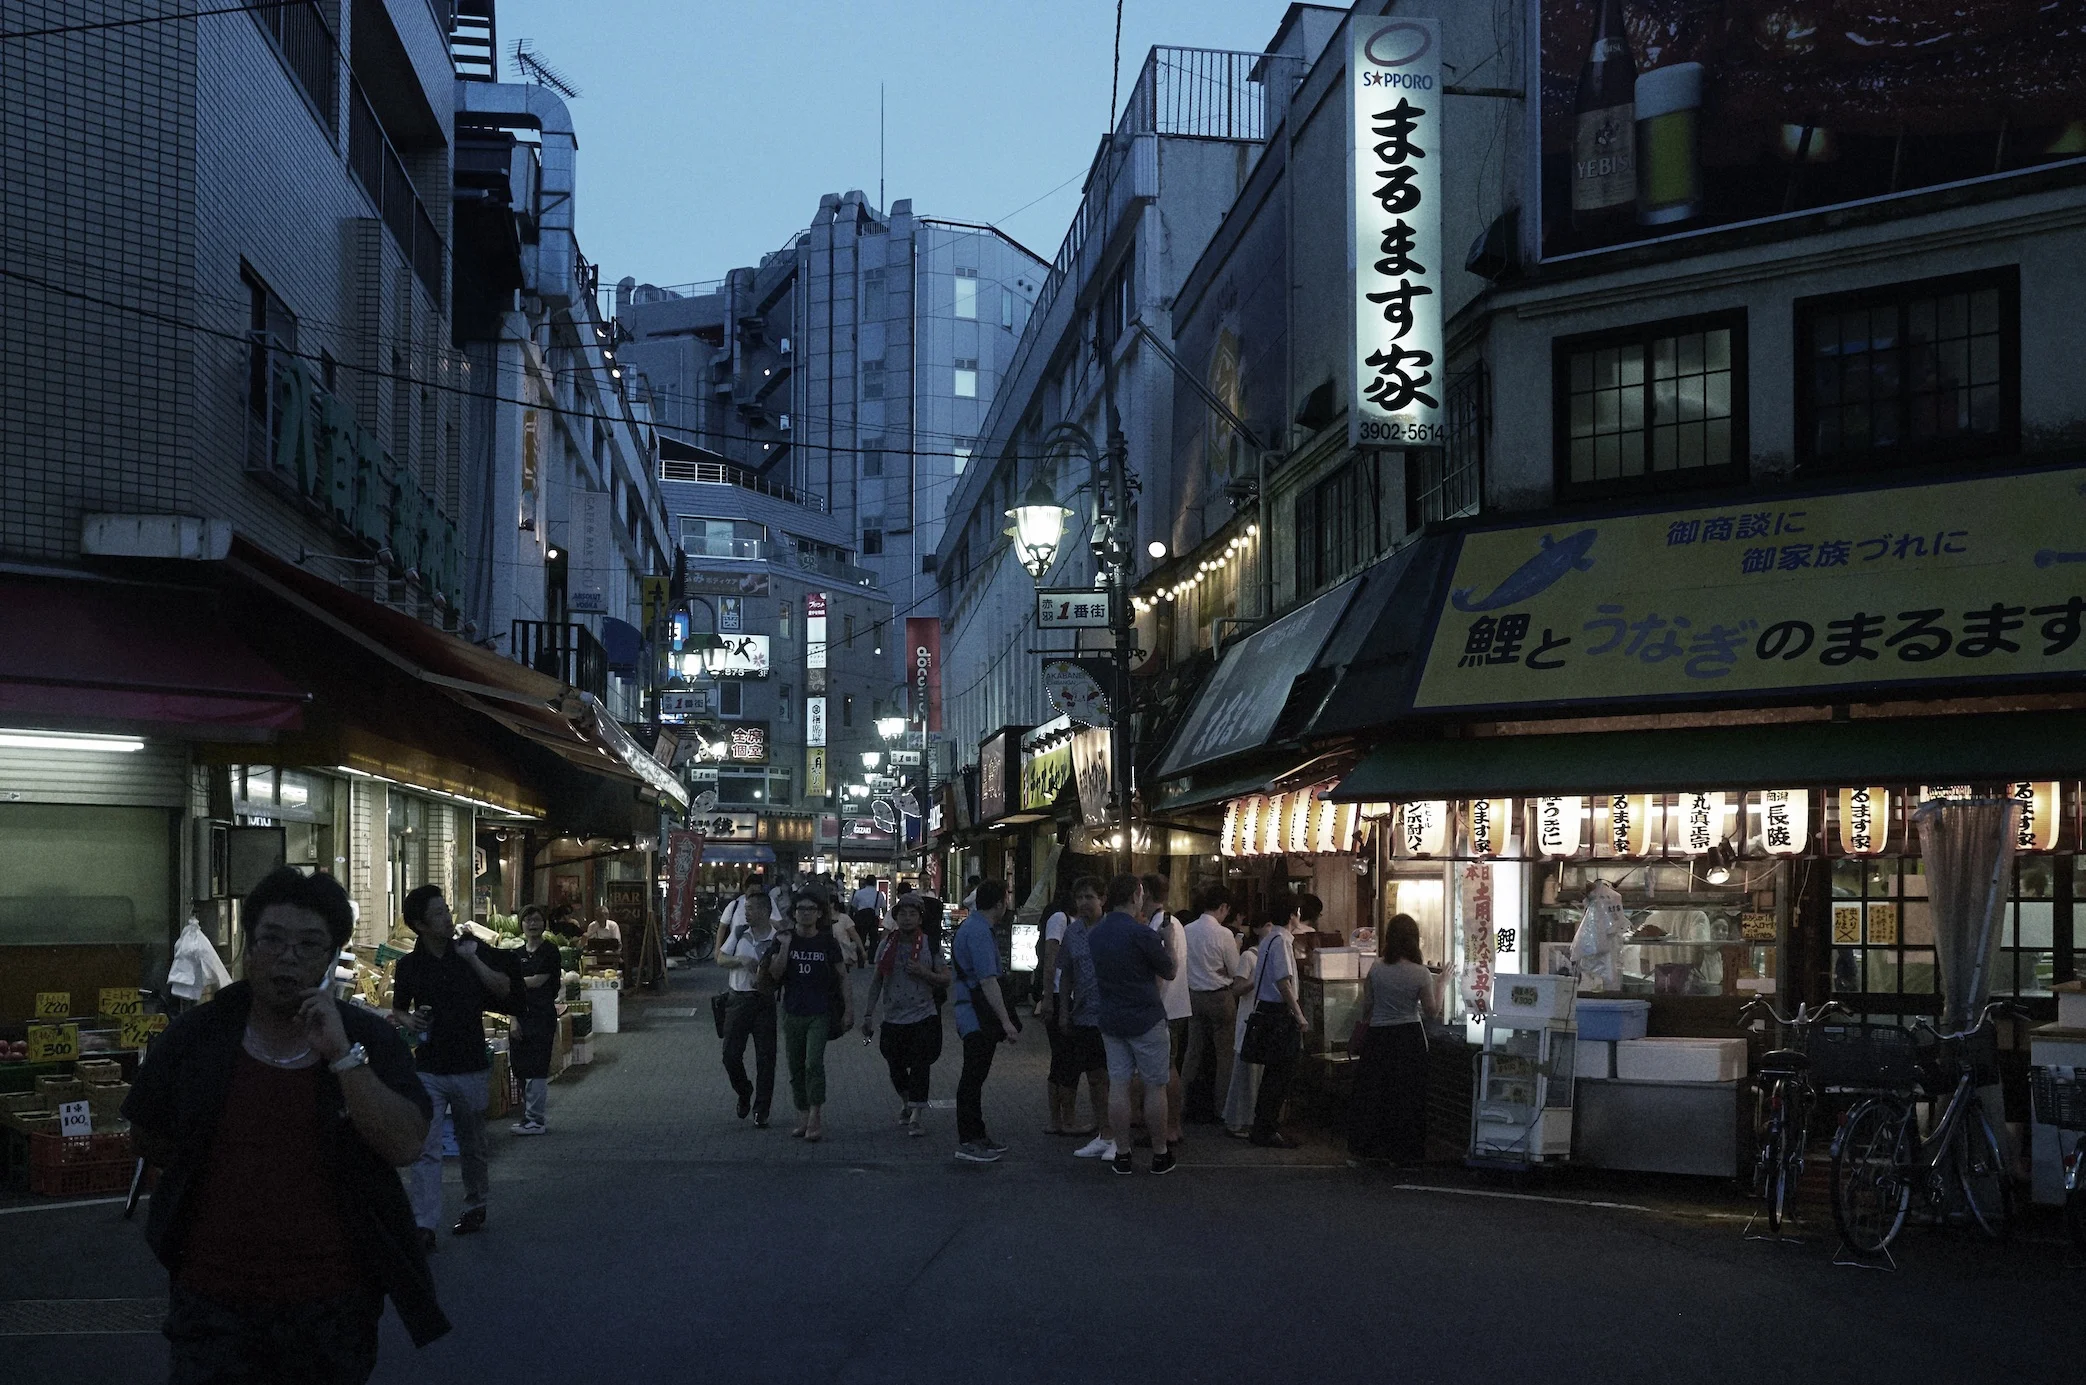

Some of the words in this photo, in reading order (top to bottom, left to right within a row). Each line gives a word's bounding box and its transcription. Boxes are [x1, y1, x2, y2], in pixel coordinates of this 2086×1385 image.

[1364, 97, 1439, 411] まるます家
[1360, 423, 1444, 442] 3902-5614
[1667, 512, 1807, 546] 御商談に
[1741, 531, 1968, 574] 御家族づれに
[732, 727, 764, 743] 全席
[1766, 804, 1792, 847] 長陵
[614, 891, 640, 902] BAR
[1497, 927, 1516, 953] 鯉
[798, 963, 812, 974] 10
[44, 1001, 69, 1014] 220
[111, 1001, 138, 1015] 200
